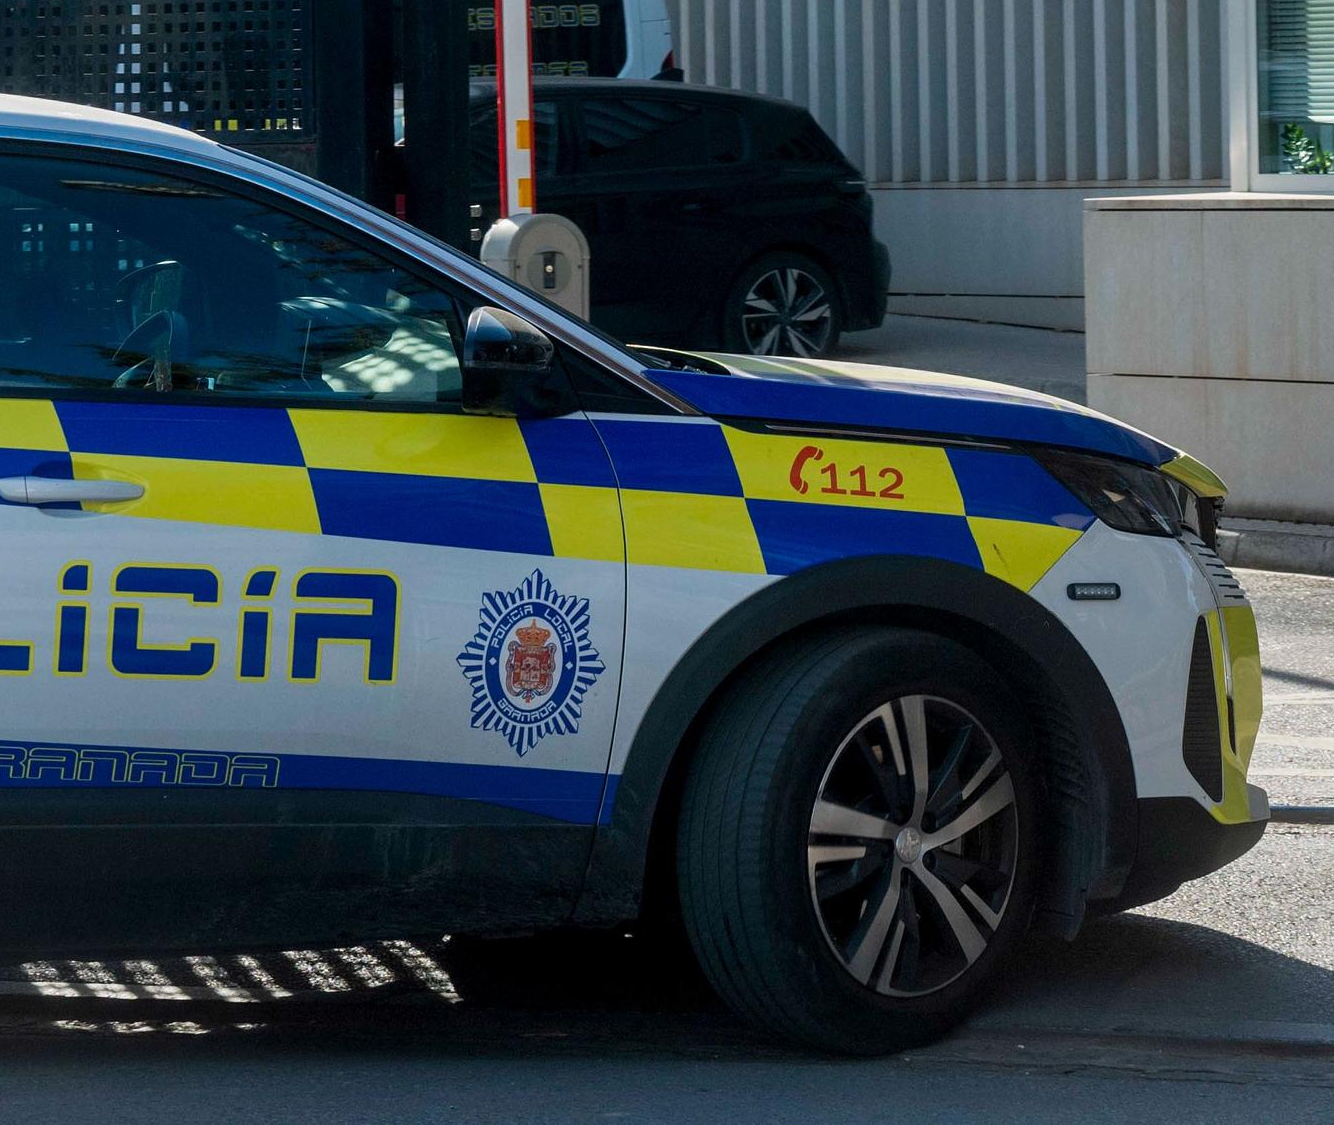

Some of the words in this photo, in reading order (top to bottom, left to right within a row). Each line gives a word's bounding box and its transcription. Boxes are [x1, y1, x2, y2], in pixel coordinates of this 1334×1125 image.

[820, 462, 905, 500] 112
[544, 610, 573, 652] LOCAL
[497, 699, 556, 722] GRANADA
